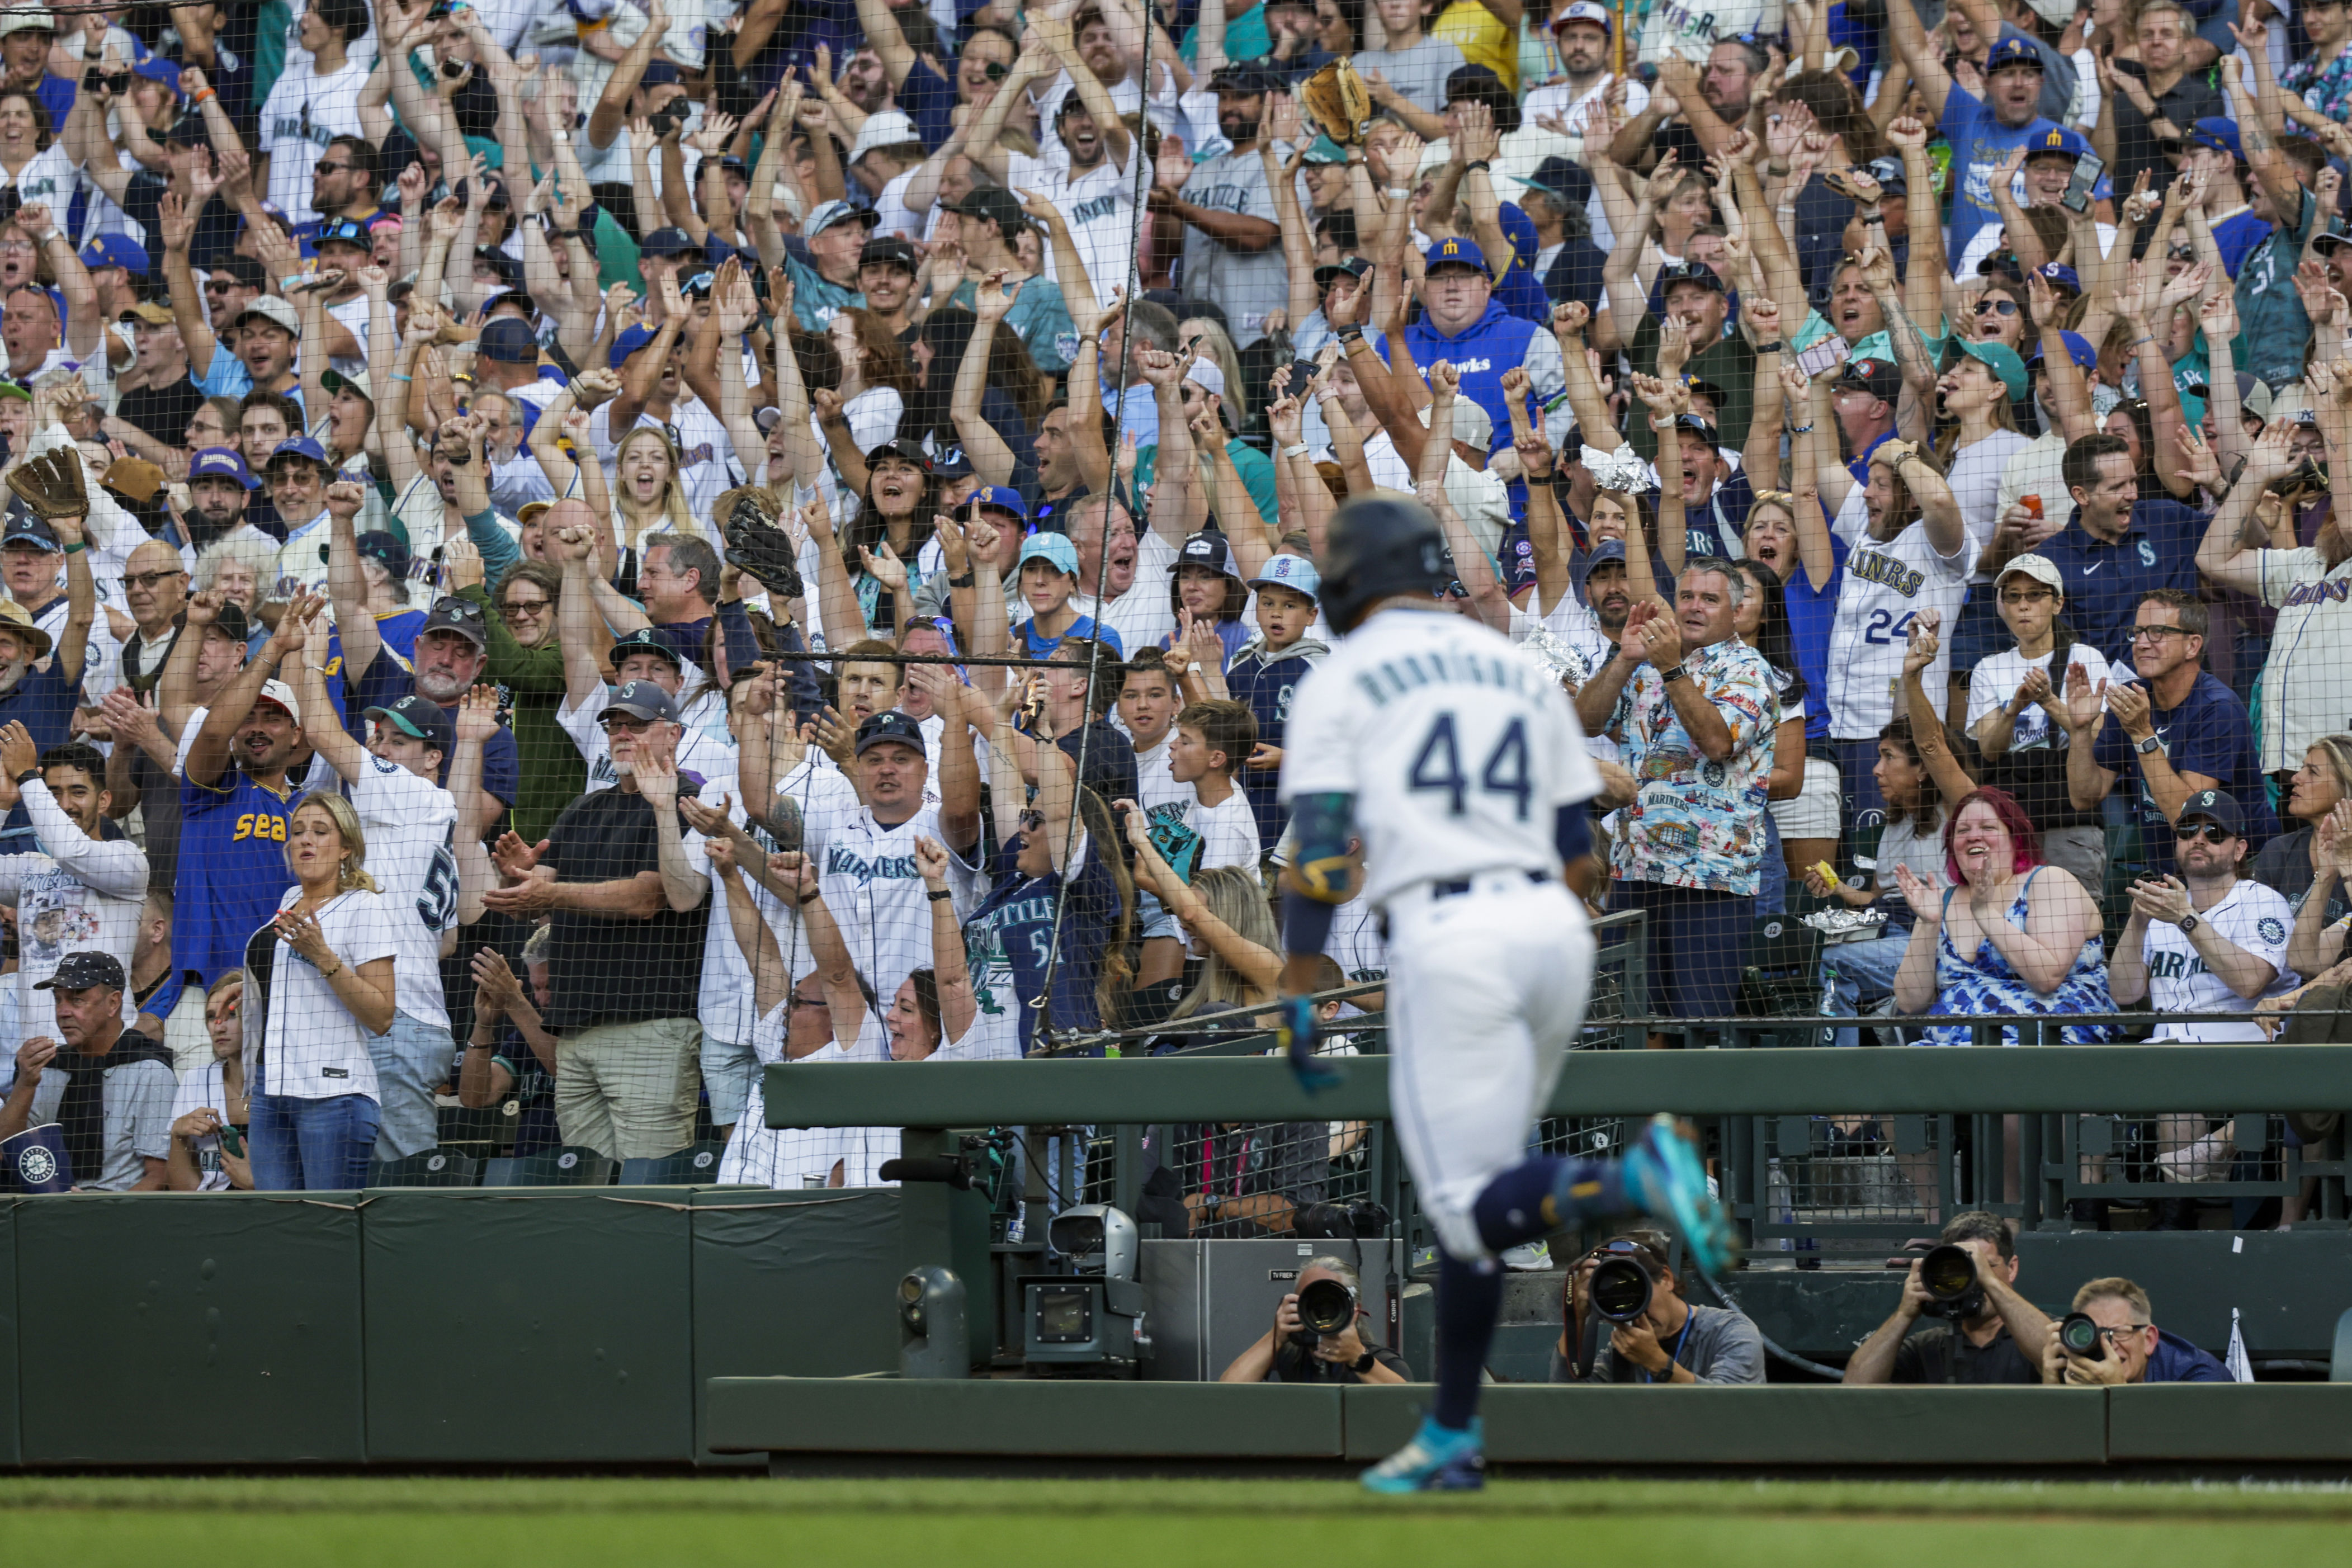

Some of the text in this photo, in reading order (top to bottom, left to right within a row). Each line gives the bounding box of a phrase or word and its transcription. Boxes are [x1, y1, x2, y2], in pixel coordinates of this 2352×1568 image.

[2138, 540, 2156, 567] S
[1407, 710, 1533, 821] 44
[1647, 793, 1690, 813] MARINERS
[2201, 791, 2216, 807] S
[2145, 811, 2169, 823] SEATTL
[1852, 878, 1859, 886] 11
[1768, 926, 1778, 934] 12
[1175, 988, 1180, 996] 9
[509, 1104, 515, 1112] 7
[1598, 1137, 1604, 1145] 4
[433, 1159, 440, 1167] 8
[698, 1155, 708, 1164] 10
